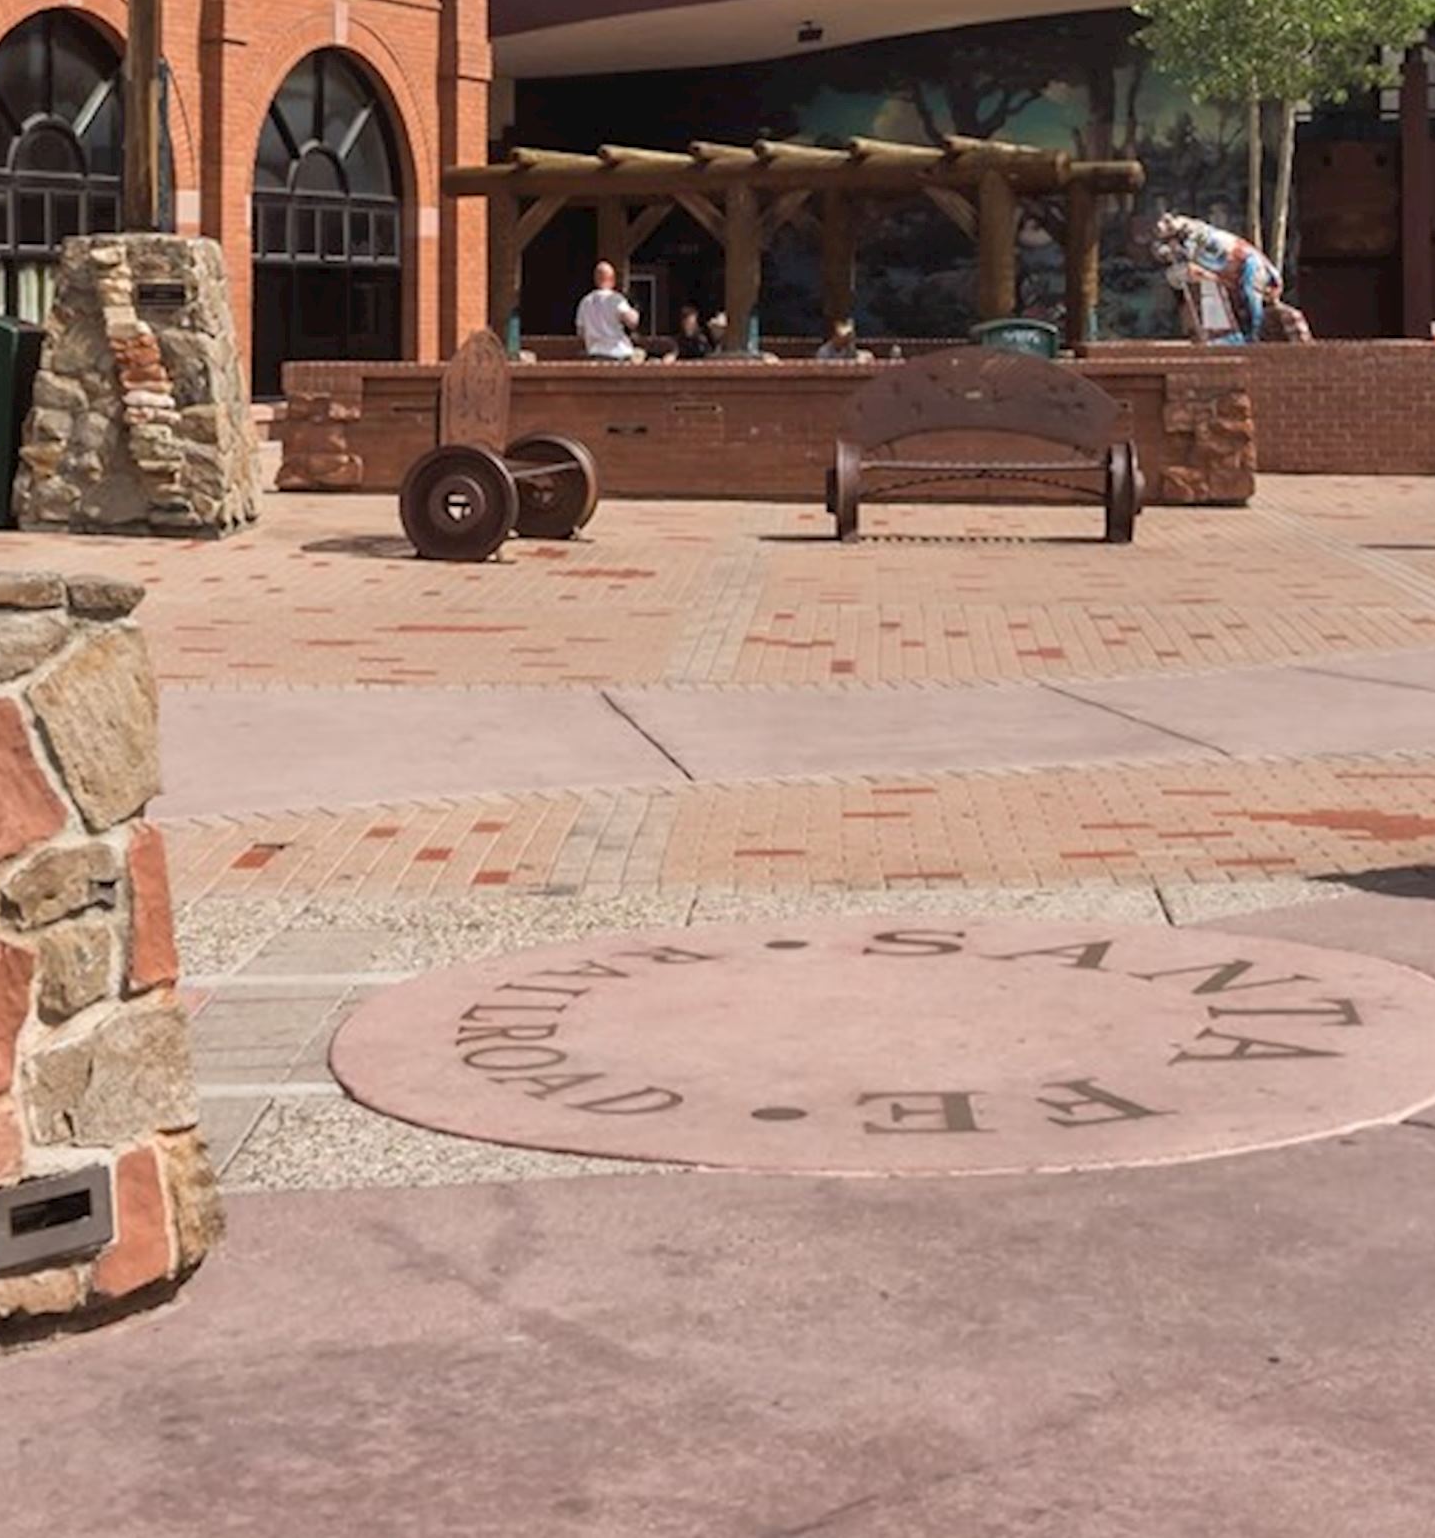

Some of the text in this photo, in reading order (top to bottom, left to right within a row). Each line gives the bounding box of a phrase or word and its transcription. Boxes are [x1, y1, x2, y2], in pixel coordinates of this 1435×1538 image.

[455, 929, 1364, 1134] SANTA FE RAILROAD
